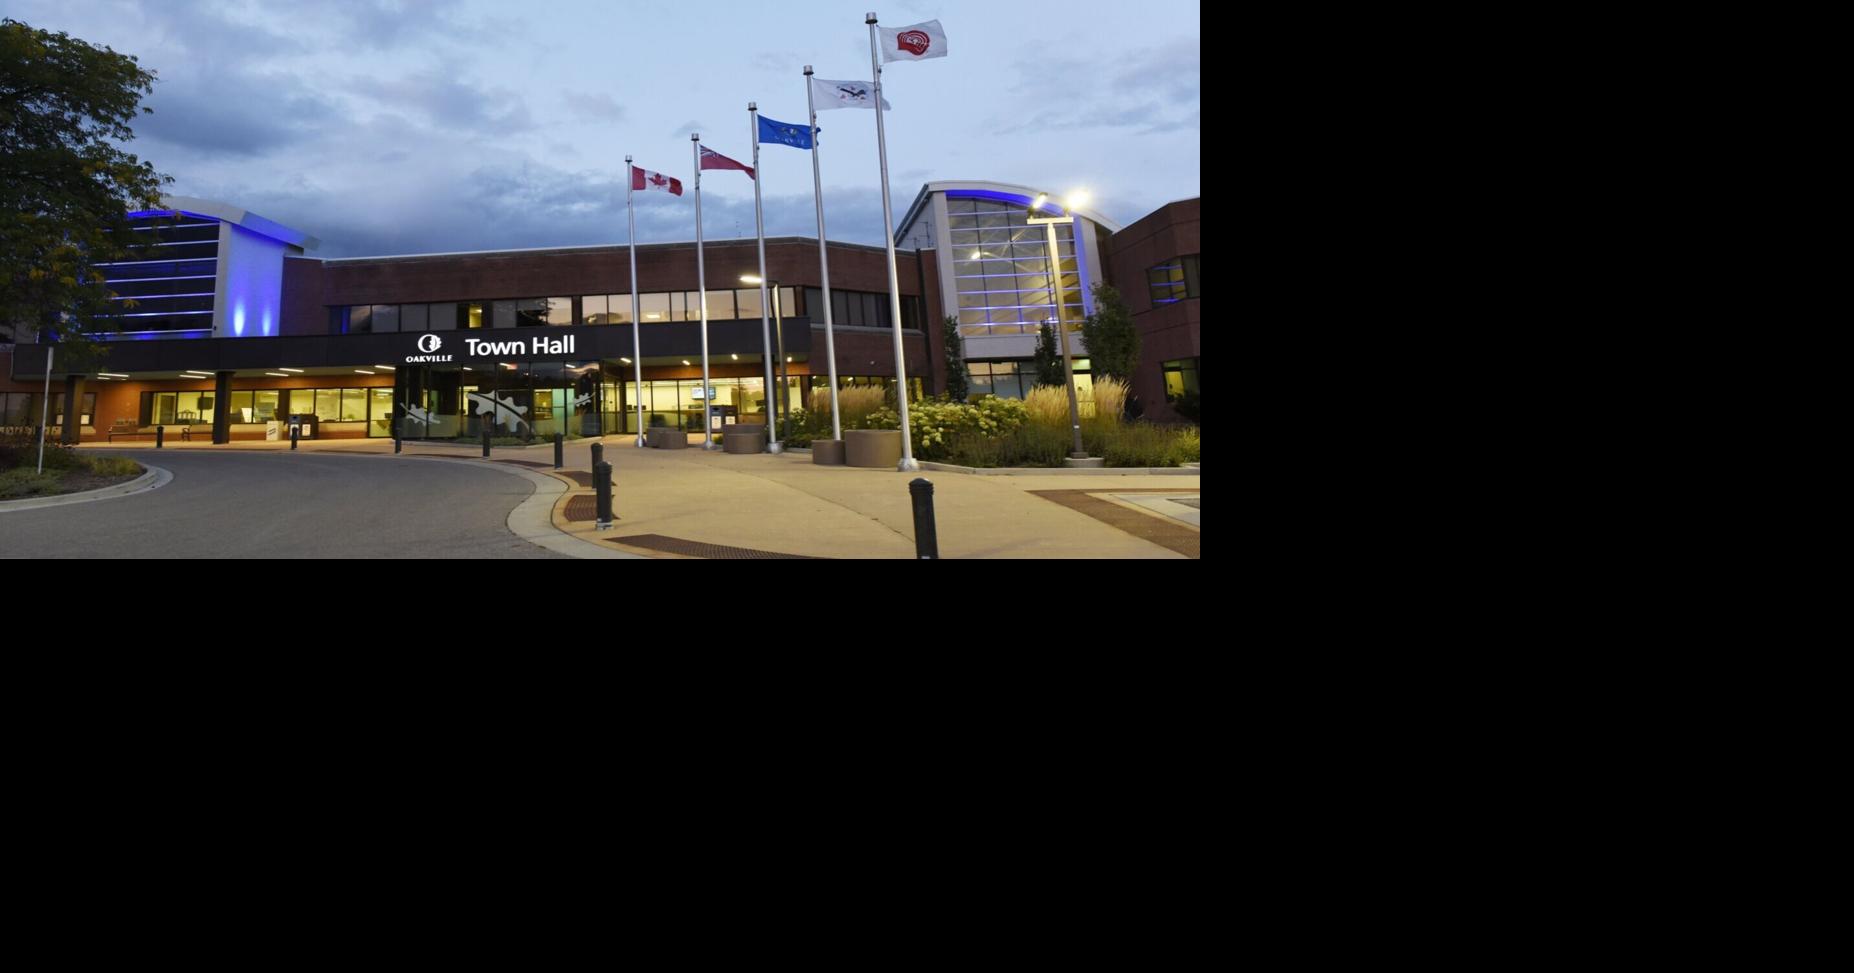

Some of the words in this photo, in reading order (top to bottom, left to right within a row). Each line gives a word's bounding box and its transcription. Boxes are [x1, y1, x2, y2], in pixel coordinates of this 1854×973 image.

[465, 338, 525, 356] Town
[532, 334, 575, 355] Hall
[405, 354, 453, 363] OAKVILLE
